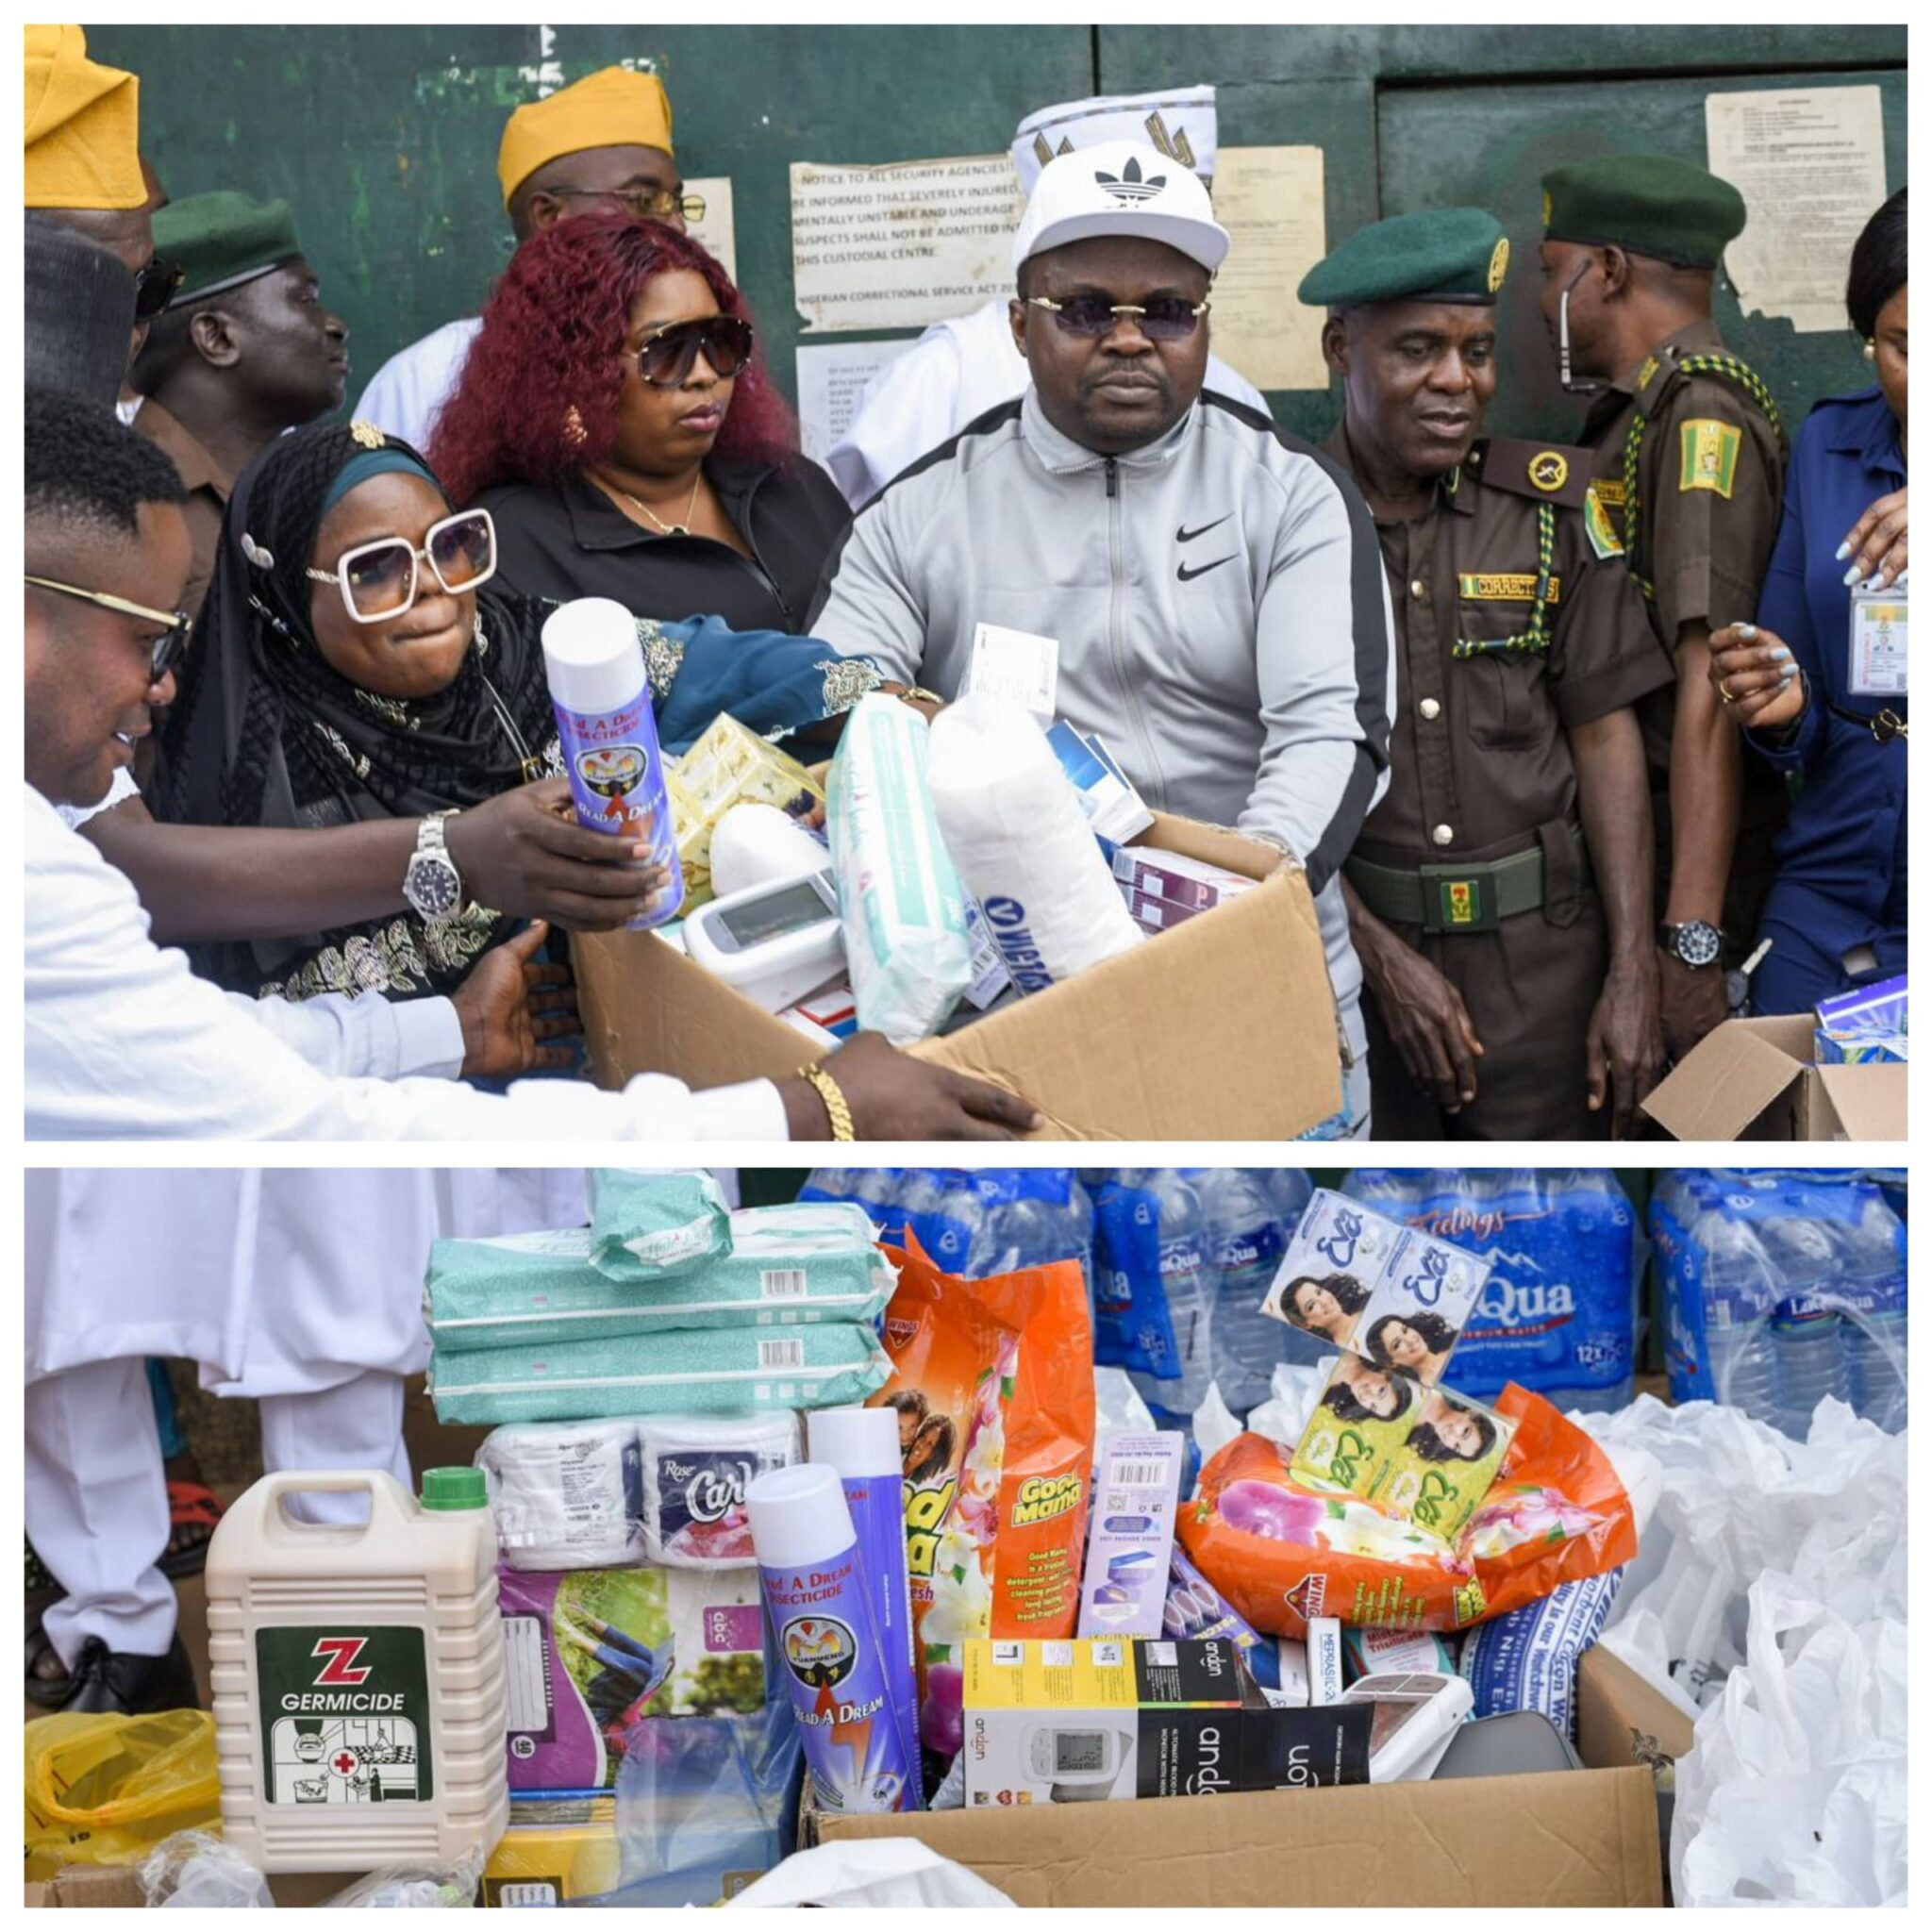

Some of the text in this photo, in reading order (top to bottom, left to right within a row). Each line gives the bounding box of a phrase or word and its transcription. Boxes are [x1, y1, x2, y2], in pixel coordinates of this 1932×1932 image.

[803, 174, 844, 186] NOTICE
[849, 172, 864, 184] TO
[868, 171, 888, 183] ALL
[891, 169, 944, 181] SECURITY
[792, 197, 806, 208] BE
[809, 194, 873, 208] INFORMED
[876, 192, 906, 204] THAT
[909, 187, 964, 202] SEVERELY
[793, 203, 1015, 227] MENTALLY UNSTABLE AND UNDERAGE
[794, 223, 1021, 247] SUSPECTS SHALL NOT BE ADMITTED INT
[795, 254, 820, 266] THIS
[823, 251, 887, 264] CUSTODIAL
[799, 283, 1017, 305] NIGERIAN CORRECTIONAL SERVICE ACT 20
[611, 810, 625, 823] A
[995, 927, 1054, 994] VICTO
[1317, 1207, 1364, 1269] Eva
[1402, 1245, 1451, 1307] Eva
[1474, 1275, 1576, 1327] Qua
[664, 1459, 696, 1483] Rose
[1021, 1470, 1077, 1504] Good
[1014, 1485, 1080, 1525] Mama
[792, 1575, 804, 1591] A
[910, 1586, 934, 1601] esh
[1309, 1574, 1326, 1618] WING
[311, 1636, 374, 1686] Z
[1205, 1641, 1226, 1676] andon
[281, 1692, 406, 1711] GERMICIDE
[822, 1707, 835, 1725] A
[839, 1695, 884, 1724] DREAM
[975, 1717, 990, 1760] andon
